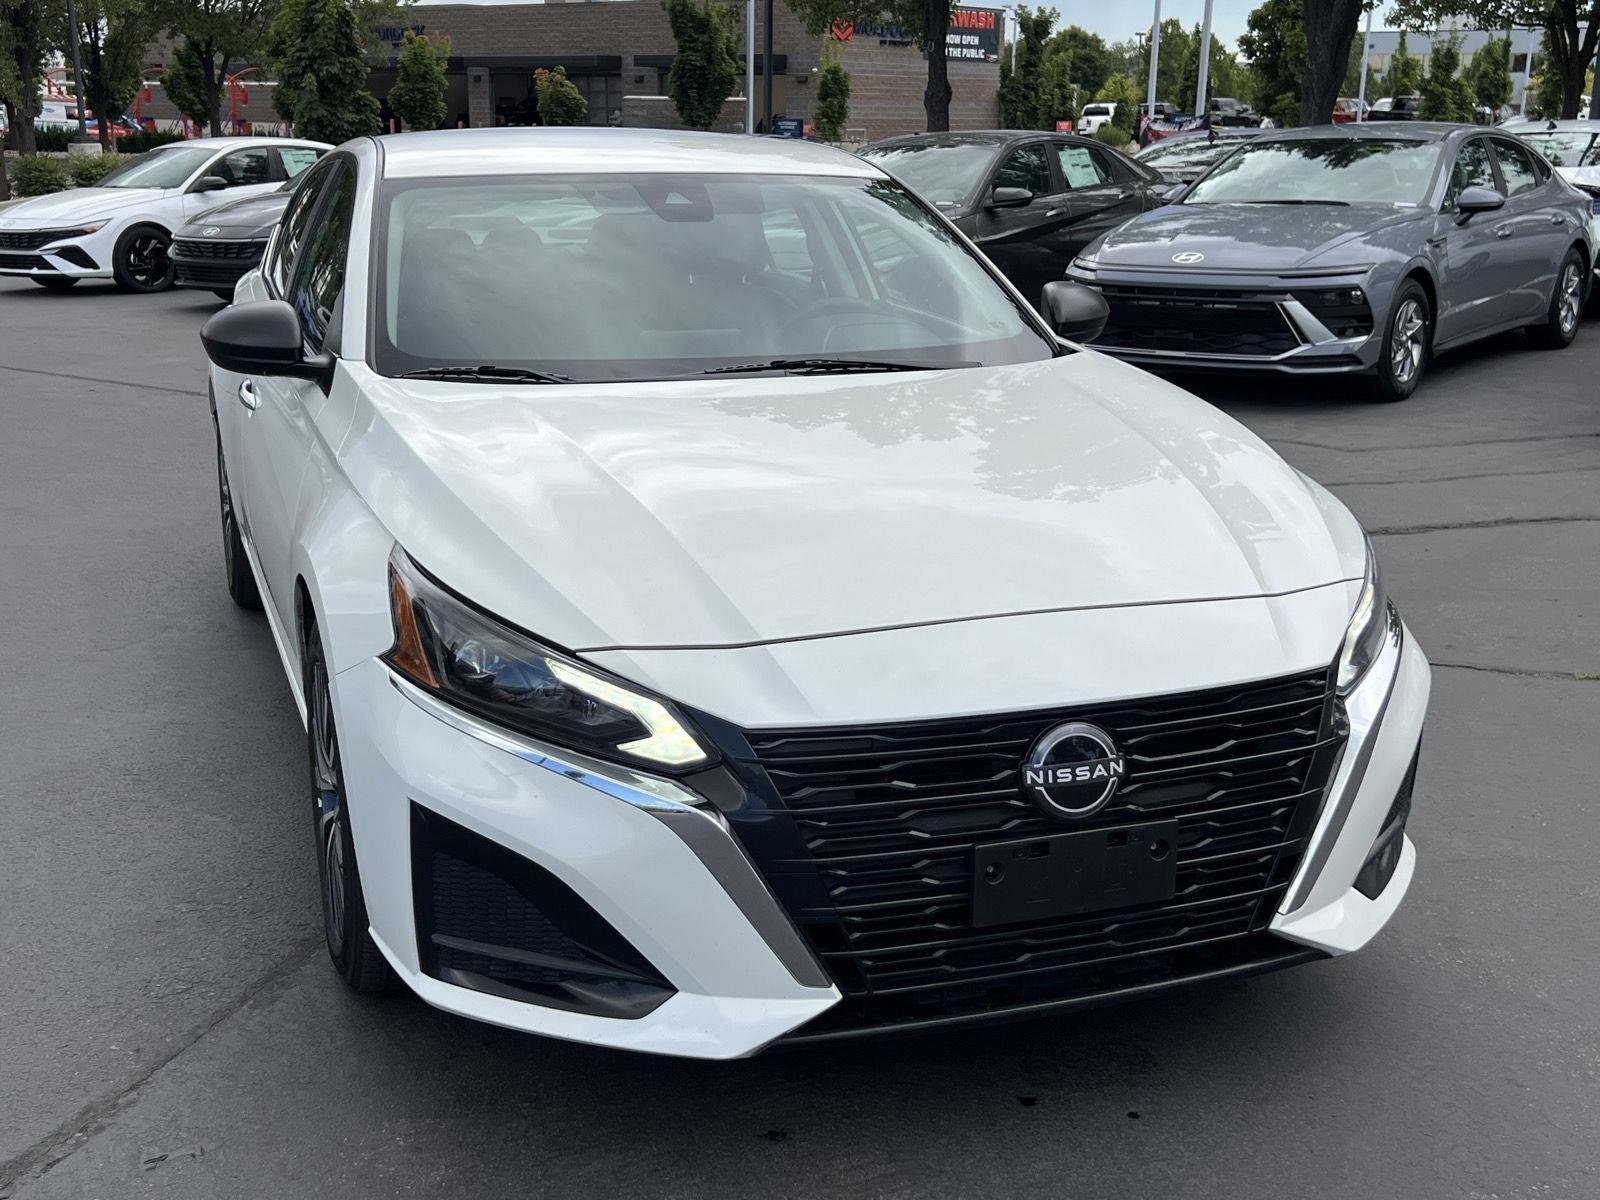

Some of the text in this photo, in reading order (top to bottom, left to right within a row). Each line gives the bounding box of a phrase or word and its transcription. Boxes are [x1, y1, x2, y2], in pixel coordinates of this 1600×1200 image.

[962, 35, 979, 46] OPEN
[949, 47, 961, 57] THE
[962, 48, 985, 59] PUBLIC
[1026, 759, 1123, 785] NISSAN
